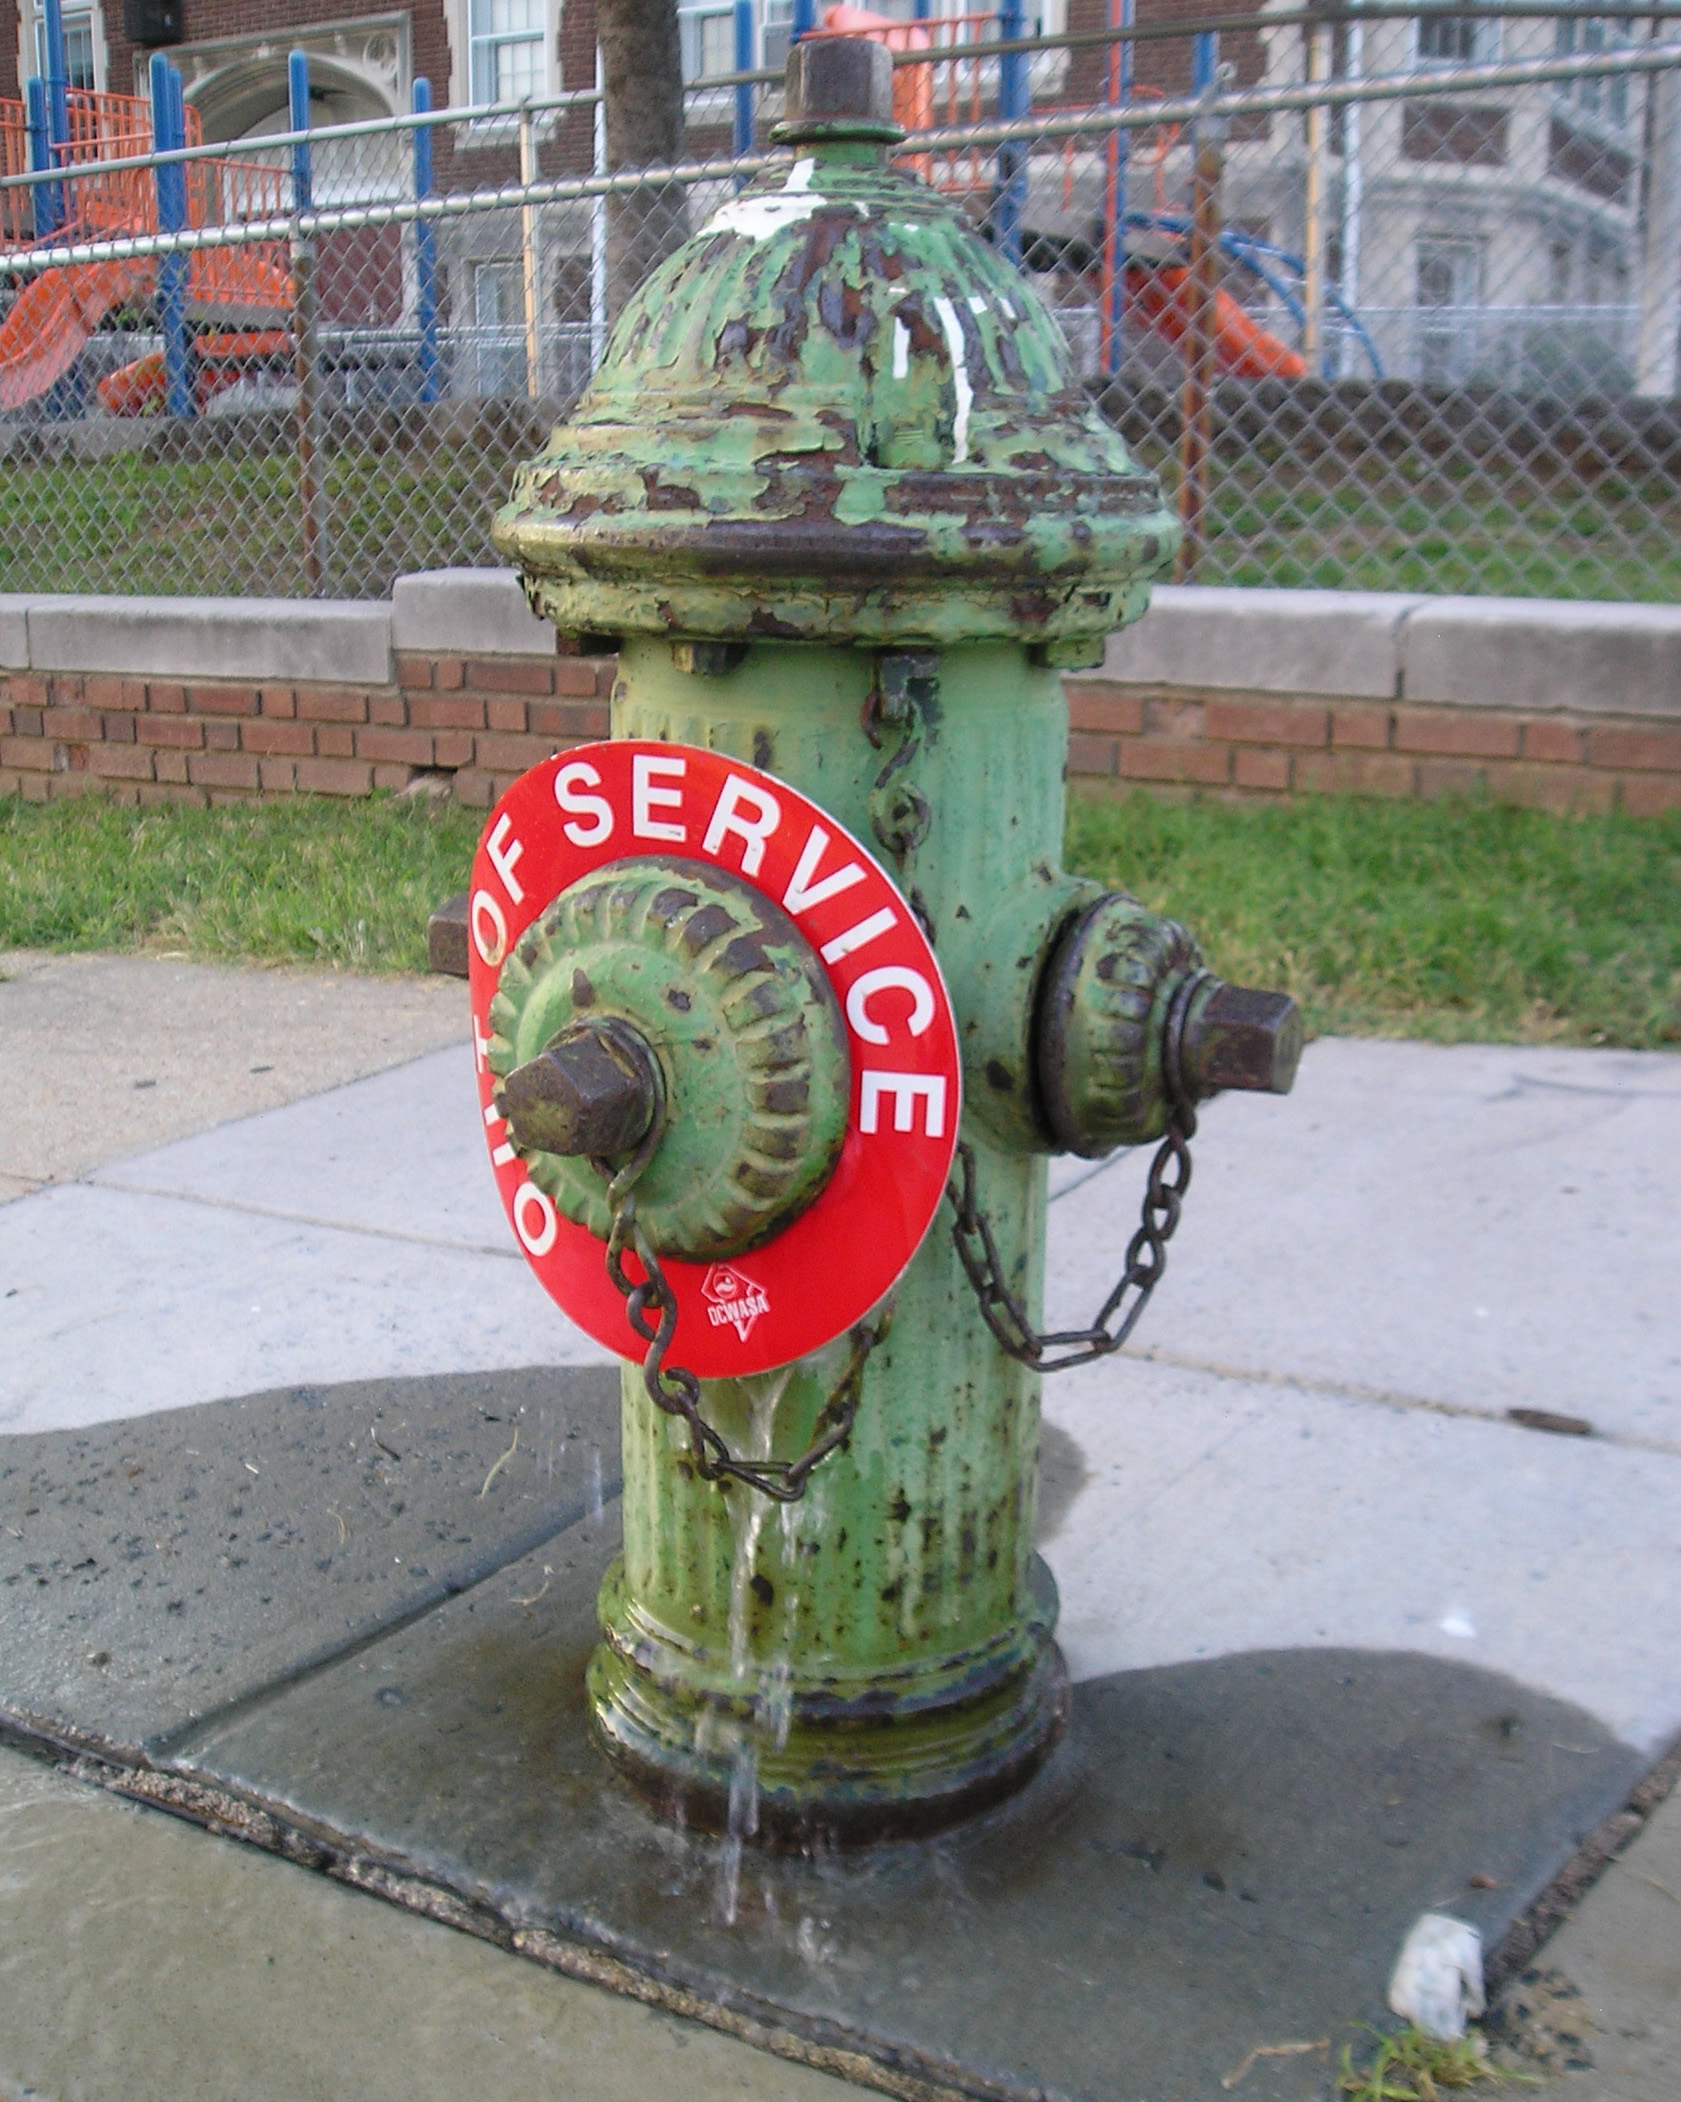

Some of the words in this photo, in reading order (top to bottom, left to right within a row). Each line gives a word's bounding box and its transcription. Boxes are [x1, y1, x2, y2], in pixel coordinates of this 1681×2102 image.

[471, 813, 524, 967] OF
[554, 754, 946, 1138] SERVICE
[707, 1294, 771, 1327] DCWASA
